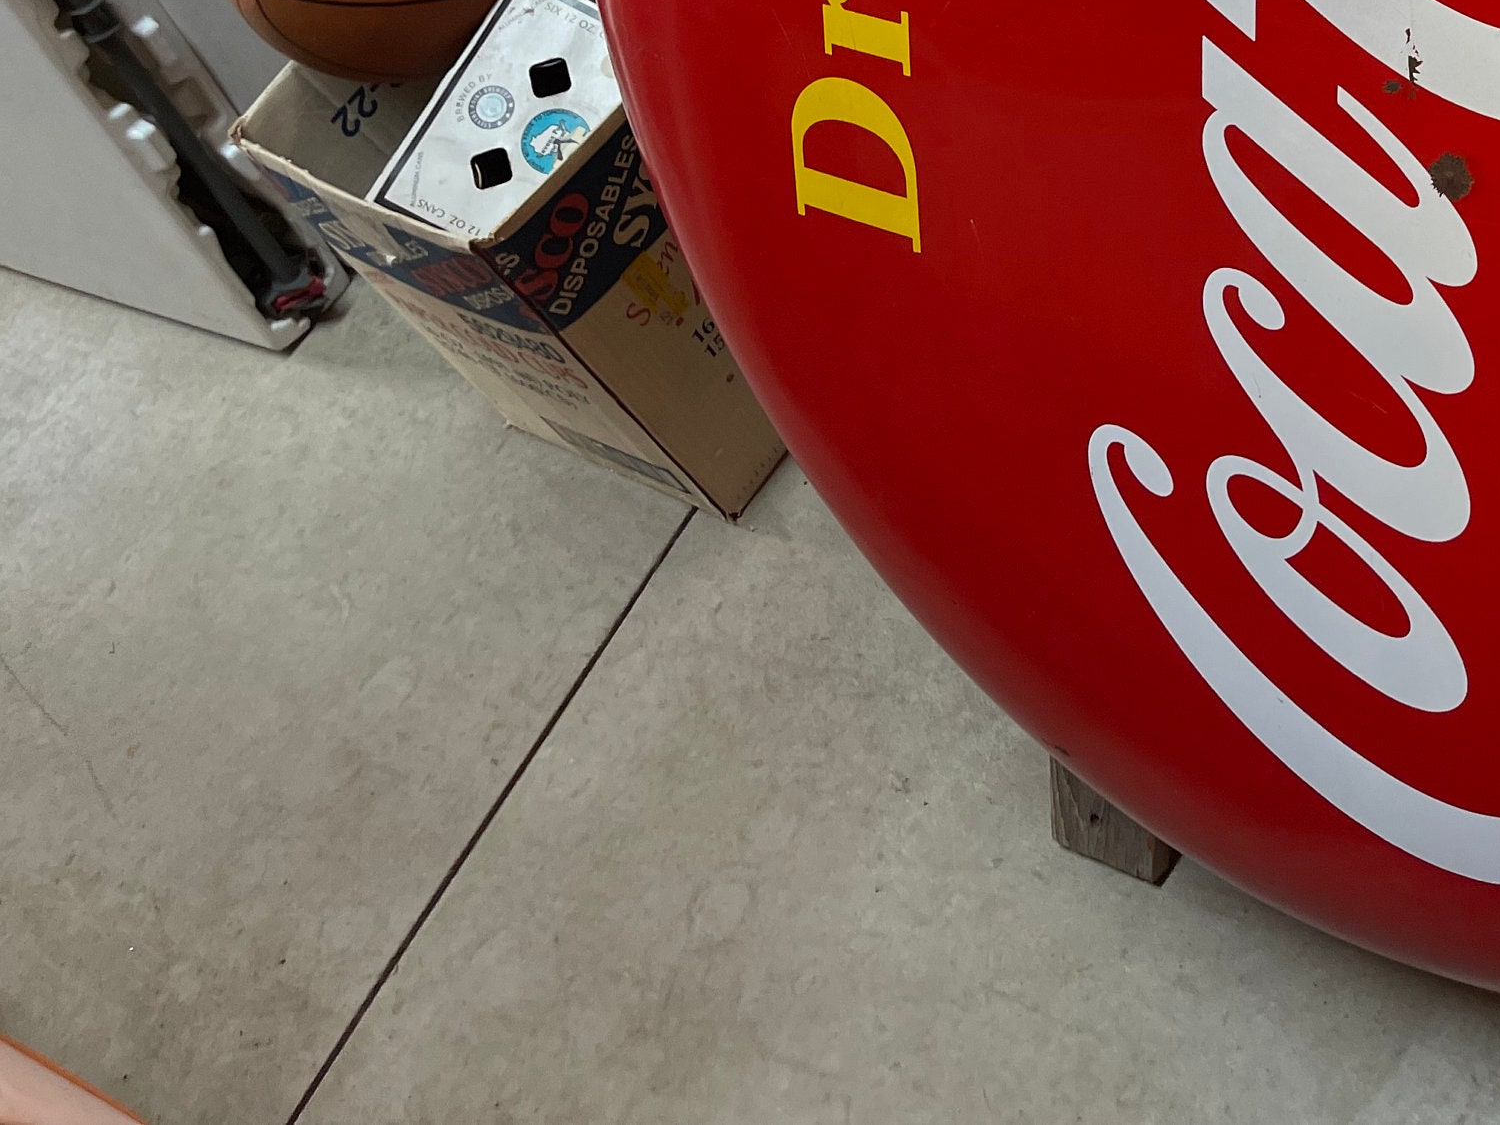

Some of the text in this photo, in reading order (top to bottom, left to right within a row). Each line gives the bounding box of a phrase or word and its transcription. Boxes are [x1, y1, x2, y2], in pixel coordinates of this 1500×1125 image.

[544, 2, 563, 16] SIX
[417, 198, 446, 219] CANS
[549, 133, 638, 316] DISPOSABLES
